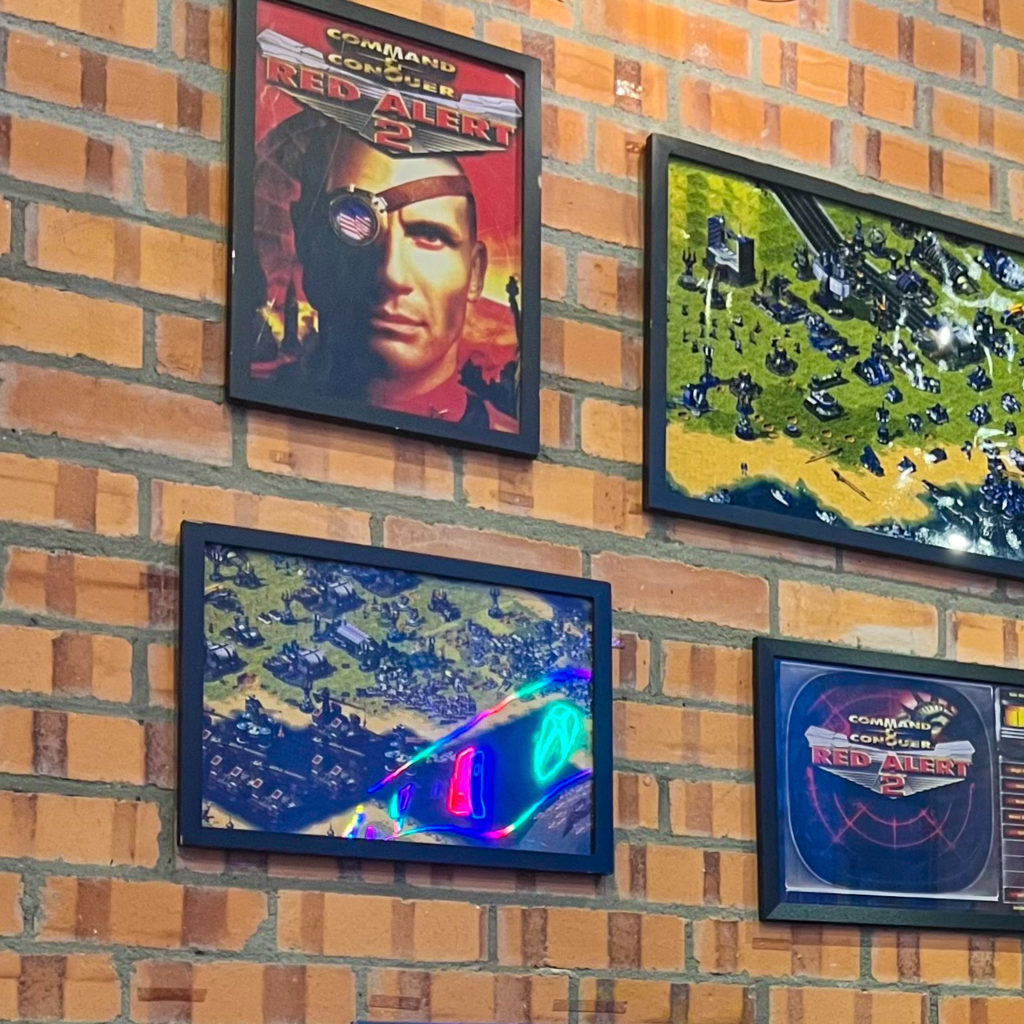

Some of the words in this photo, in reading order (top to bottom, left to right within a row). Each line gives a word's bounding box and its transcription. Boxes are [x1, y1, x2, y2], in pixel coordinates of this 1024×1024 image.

[327, 28, 456, 73] COMMAND
[328, 54, 455, 98] CONQUER
[266, 58, 361, 102] RED
[372, 90, 517, 147] ALERT
[374, 118, 413, 153] 2
[848, 715, 932, 731] COMMAND
[849, 733, 931, 749] CONQUER
[811, 746, 872, 768] RED
[879, 750, 968, 777] ALERT
[879, 774, 907, 797] 2
